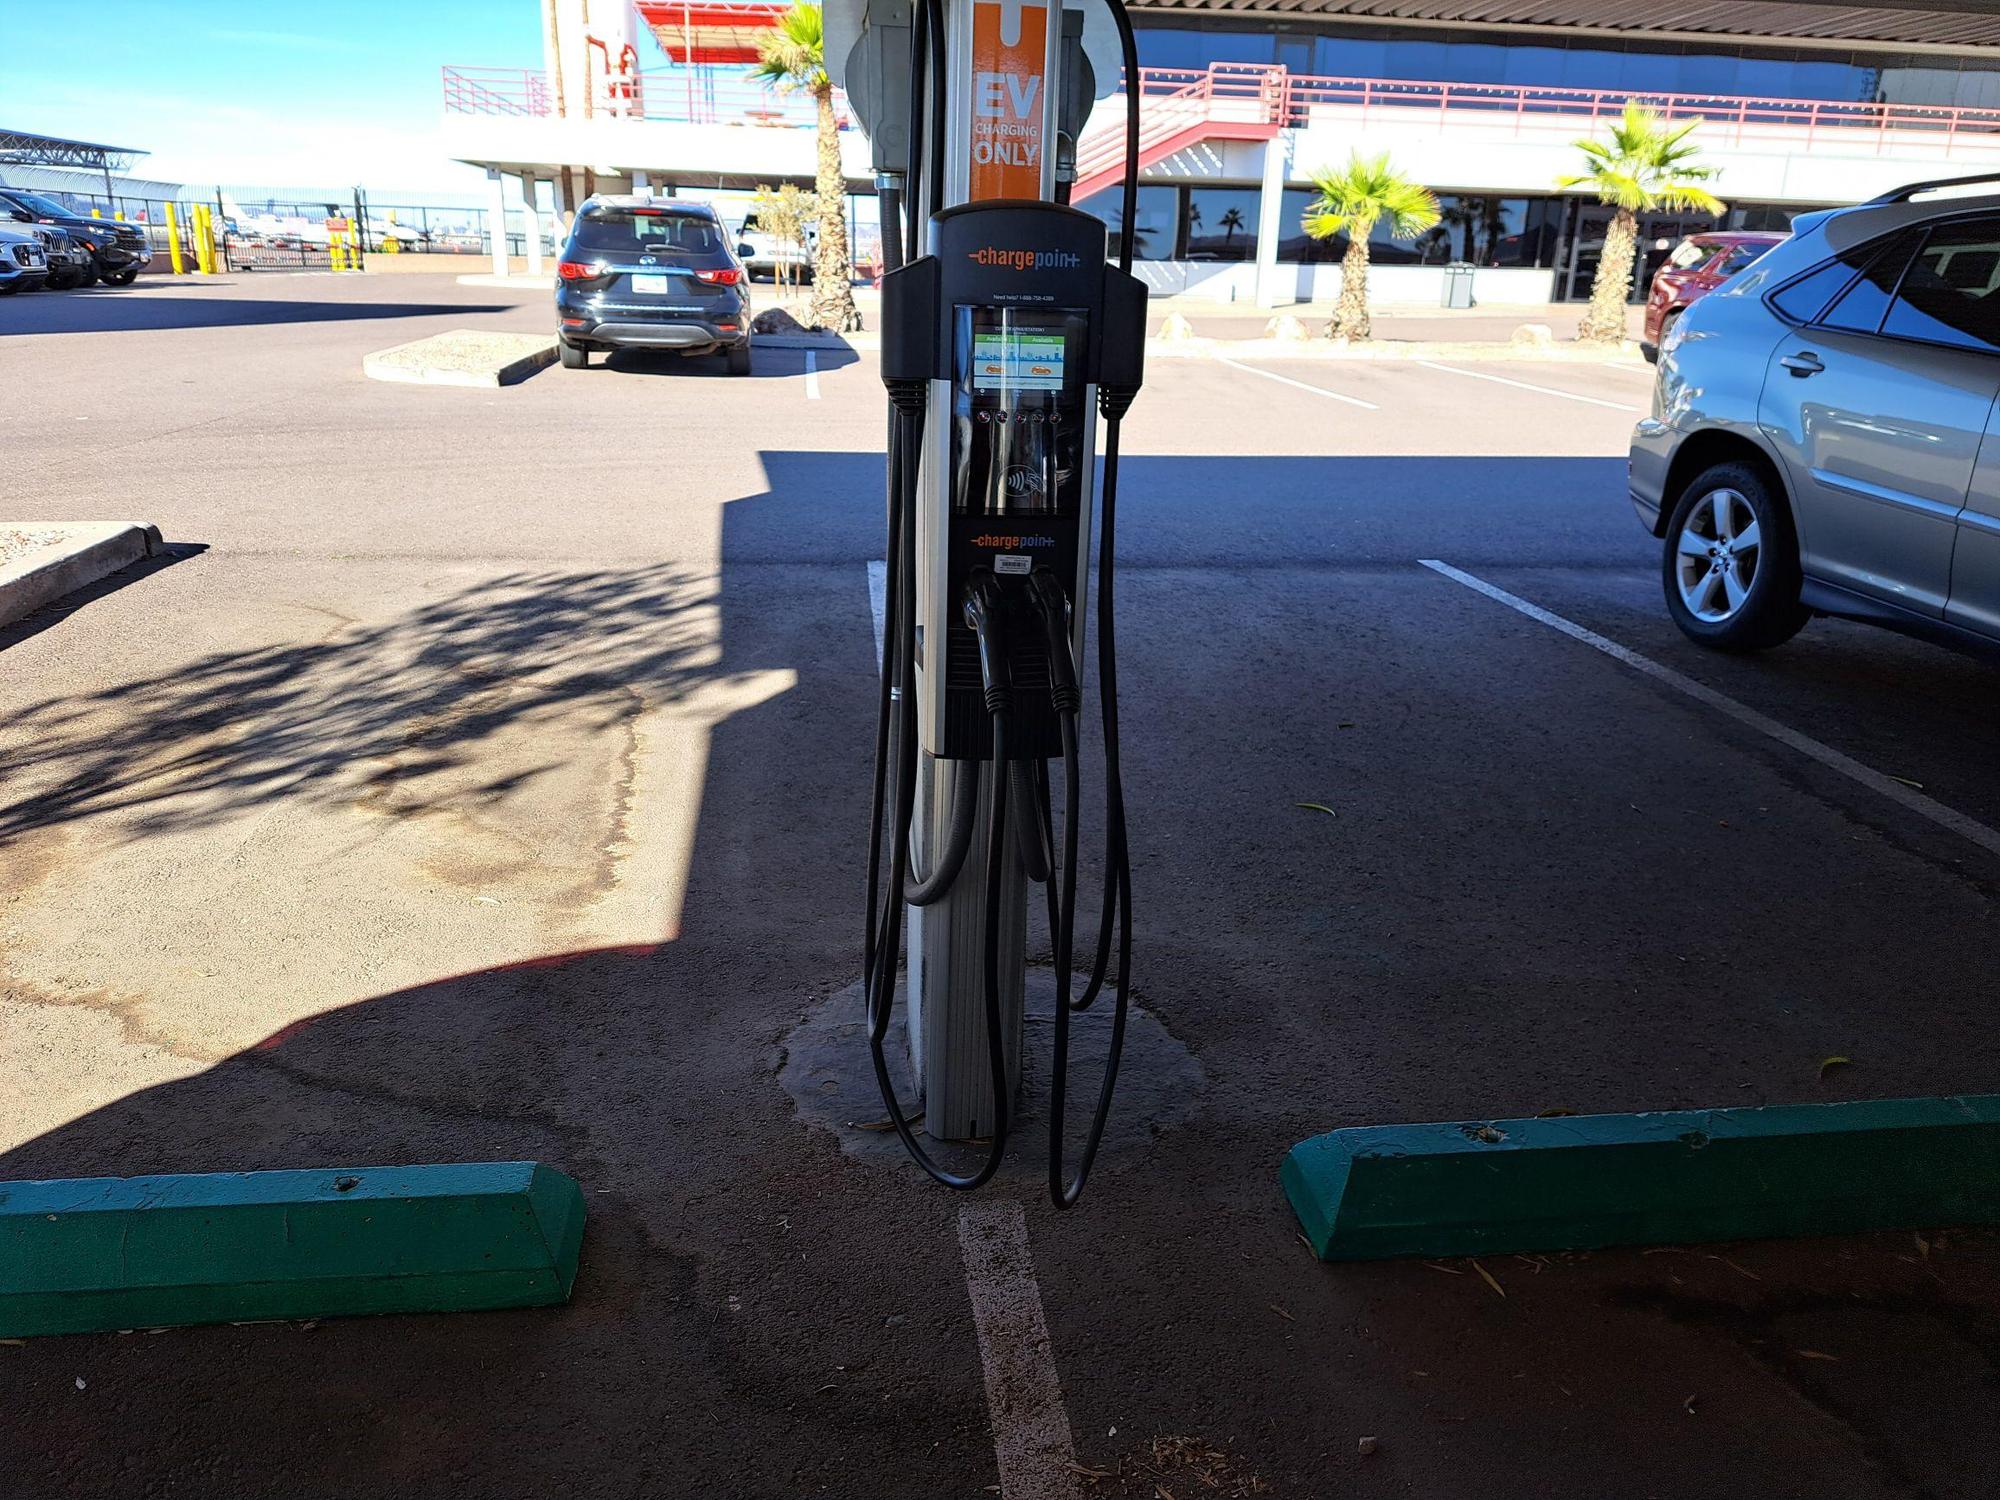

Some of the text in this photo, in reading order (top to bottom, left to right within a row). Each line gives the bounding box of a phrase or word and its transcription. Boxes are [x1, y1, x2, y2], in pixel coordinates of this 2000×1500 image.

[976, 73, 1041, 119] EV
[975, 122, 1038, 137] CHARGING
[974, 141, 1039, 167] ONLY
